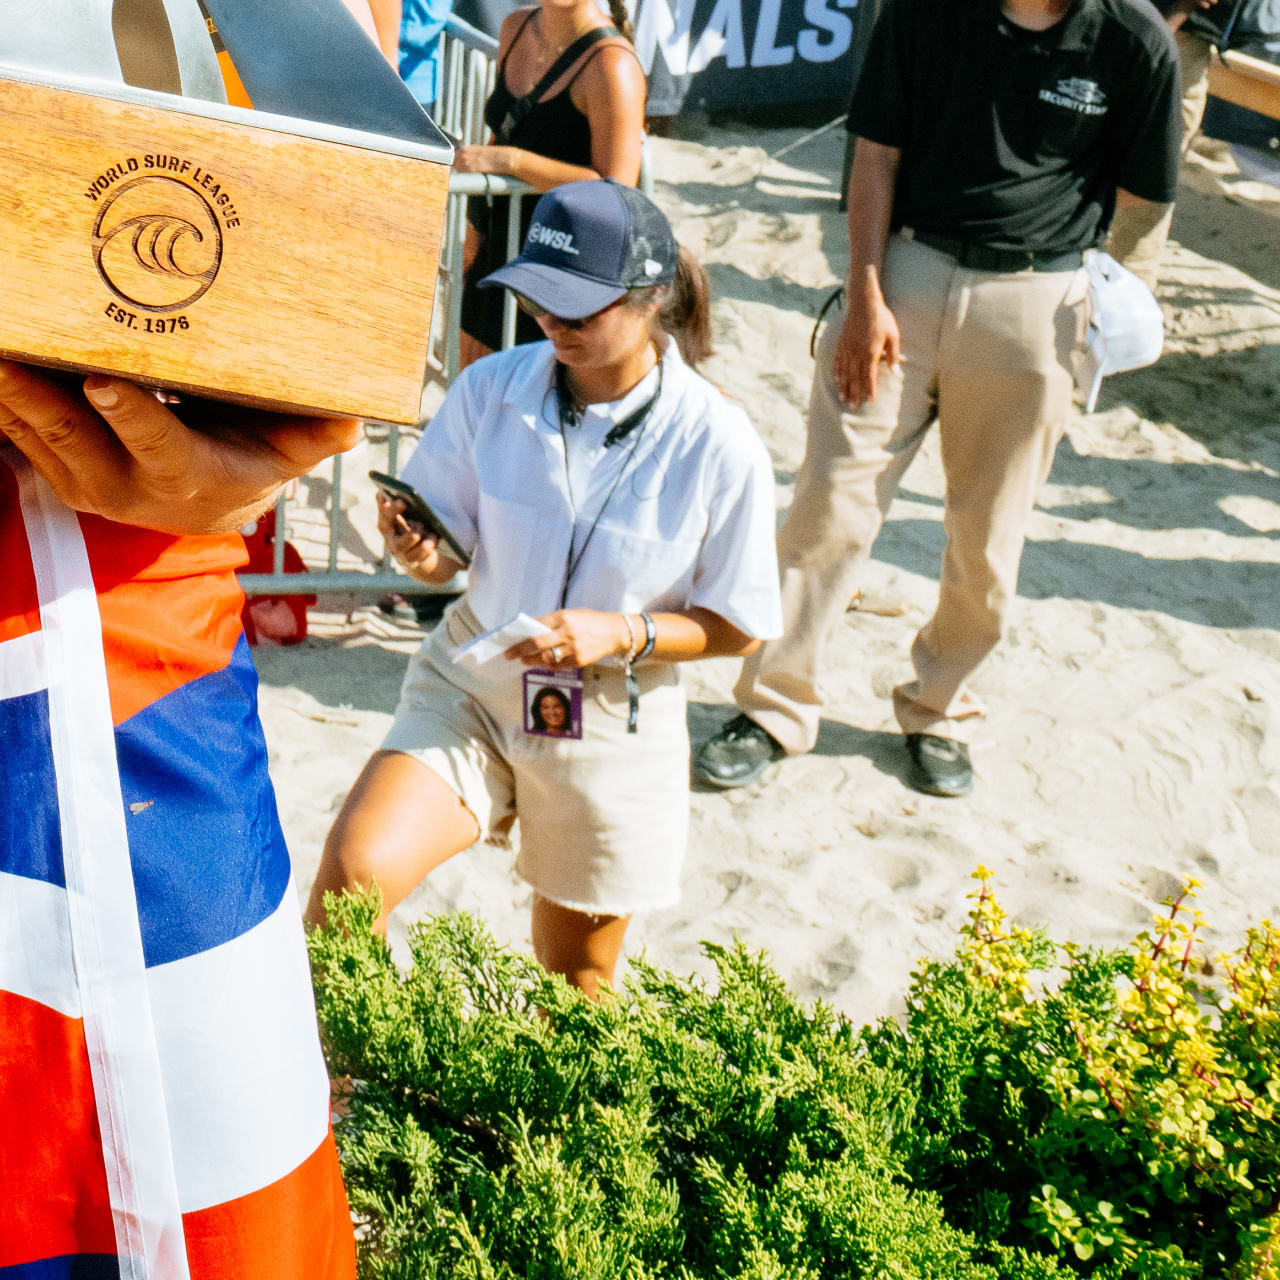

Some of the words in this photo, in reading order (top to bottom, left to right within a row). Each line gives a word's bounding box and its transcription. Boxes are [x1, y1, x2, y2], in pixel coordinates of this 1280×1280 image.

[84, 157, 139, 202] WORLD
[144, 153, 192, 174] SURF
[192, 167, 241, 230] LEAGUE
[539, 227, 579, 255] WSL
[104, 301, 138, 330] EST.
[143, 315, 190, 334] 1976
